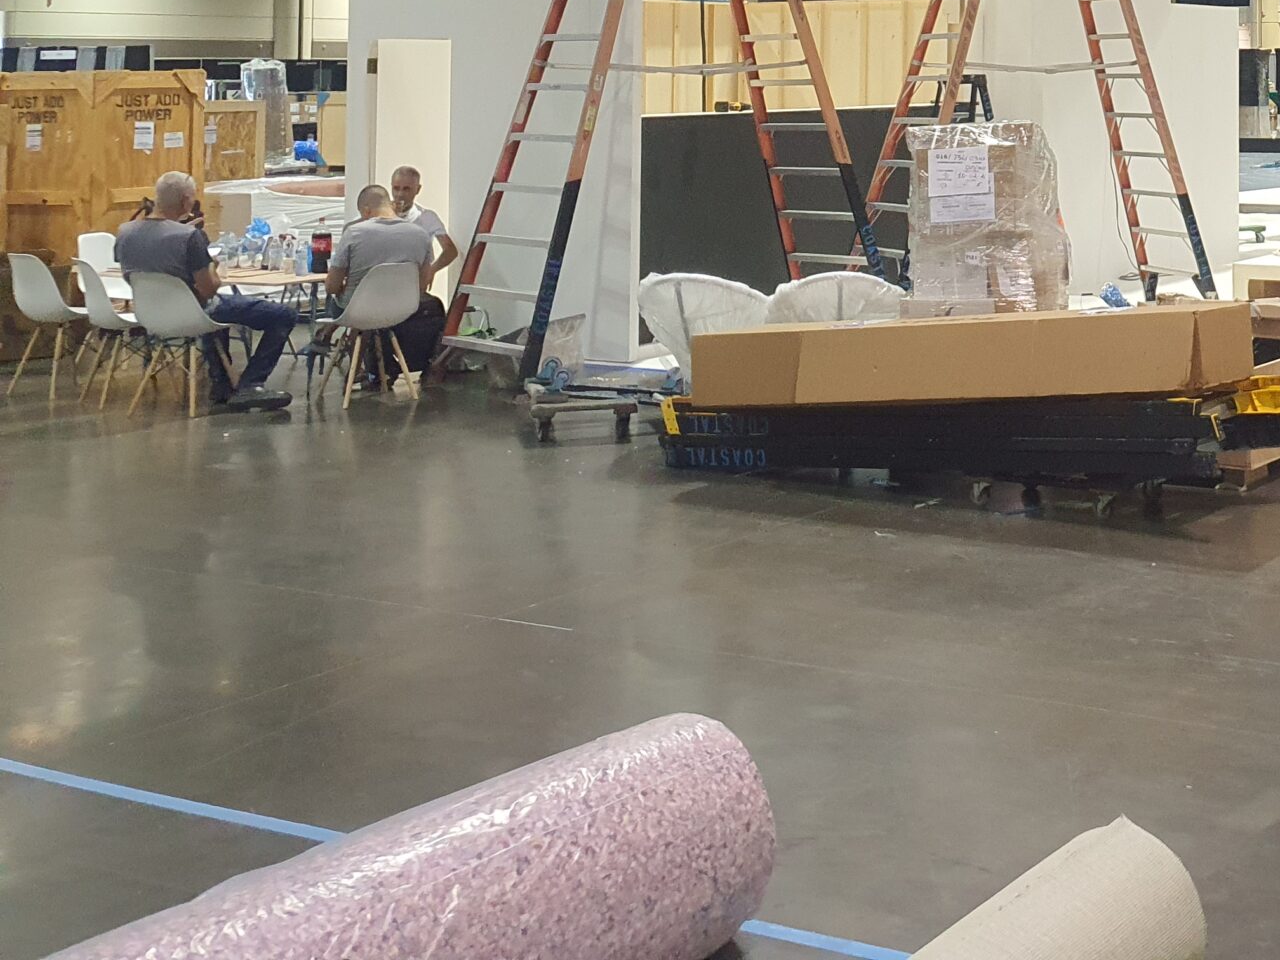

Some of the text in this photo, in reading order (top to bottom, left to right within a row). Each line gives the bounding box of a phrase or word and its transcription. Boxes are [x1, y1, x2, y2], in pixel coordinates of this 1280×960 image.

[11, 95, 65, 109] JUST ADD
[115, 93, 181, 108] JUST ADD
[17, 111, 58, 124] POWER
[124, 108, 172, 122] POWER
[686, 447, 766, 466] COASTAL
